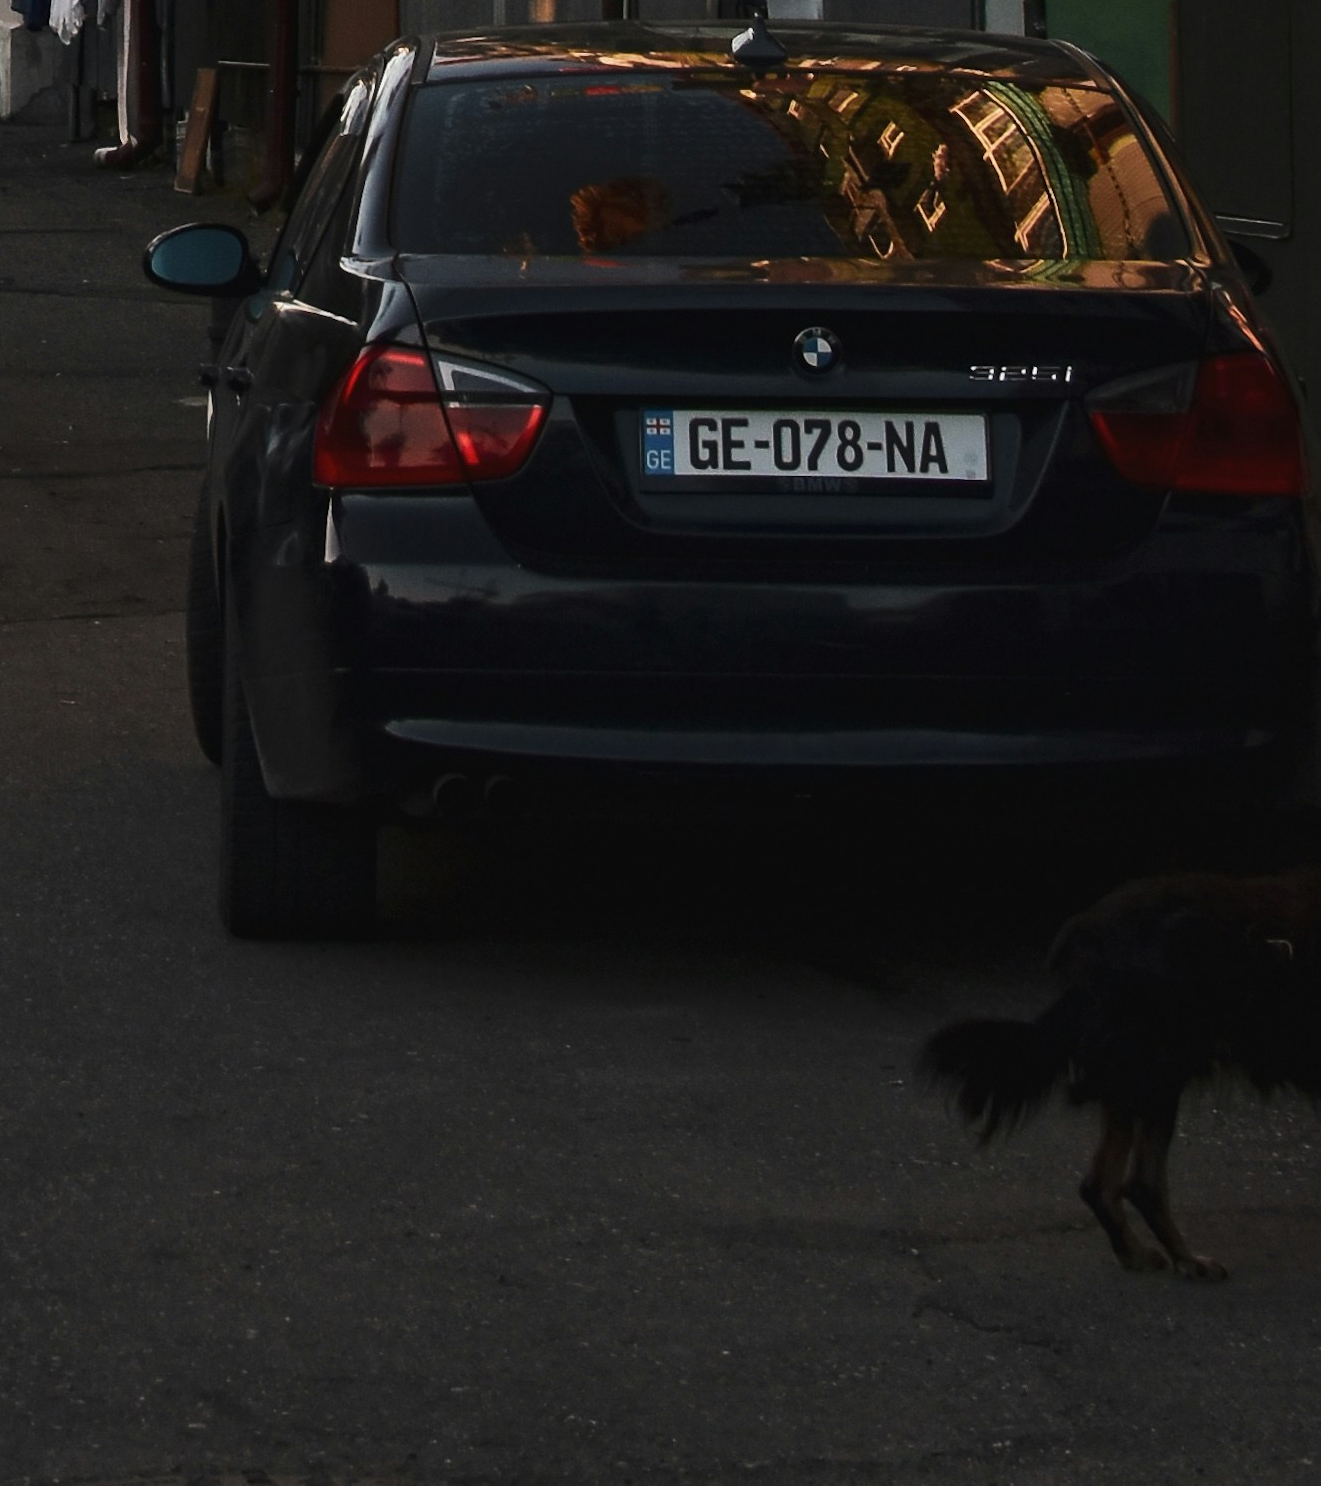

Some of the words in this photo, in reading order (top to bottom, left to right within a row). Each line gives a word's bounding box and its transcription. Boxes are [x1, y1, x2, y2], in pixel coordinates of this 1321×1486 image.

[968, 365, 1073, 382] 325i
[689, 417, 948, 474] GE-078-NA
[646, 449, 671, 471] GE
